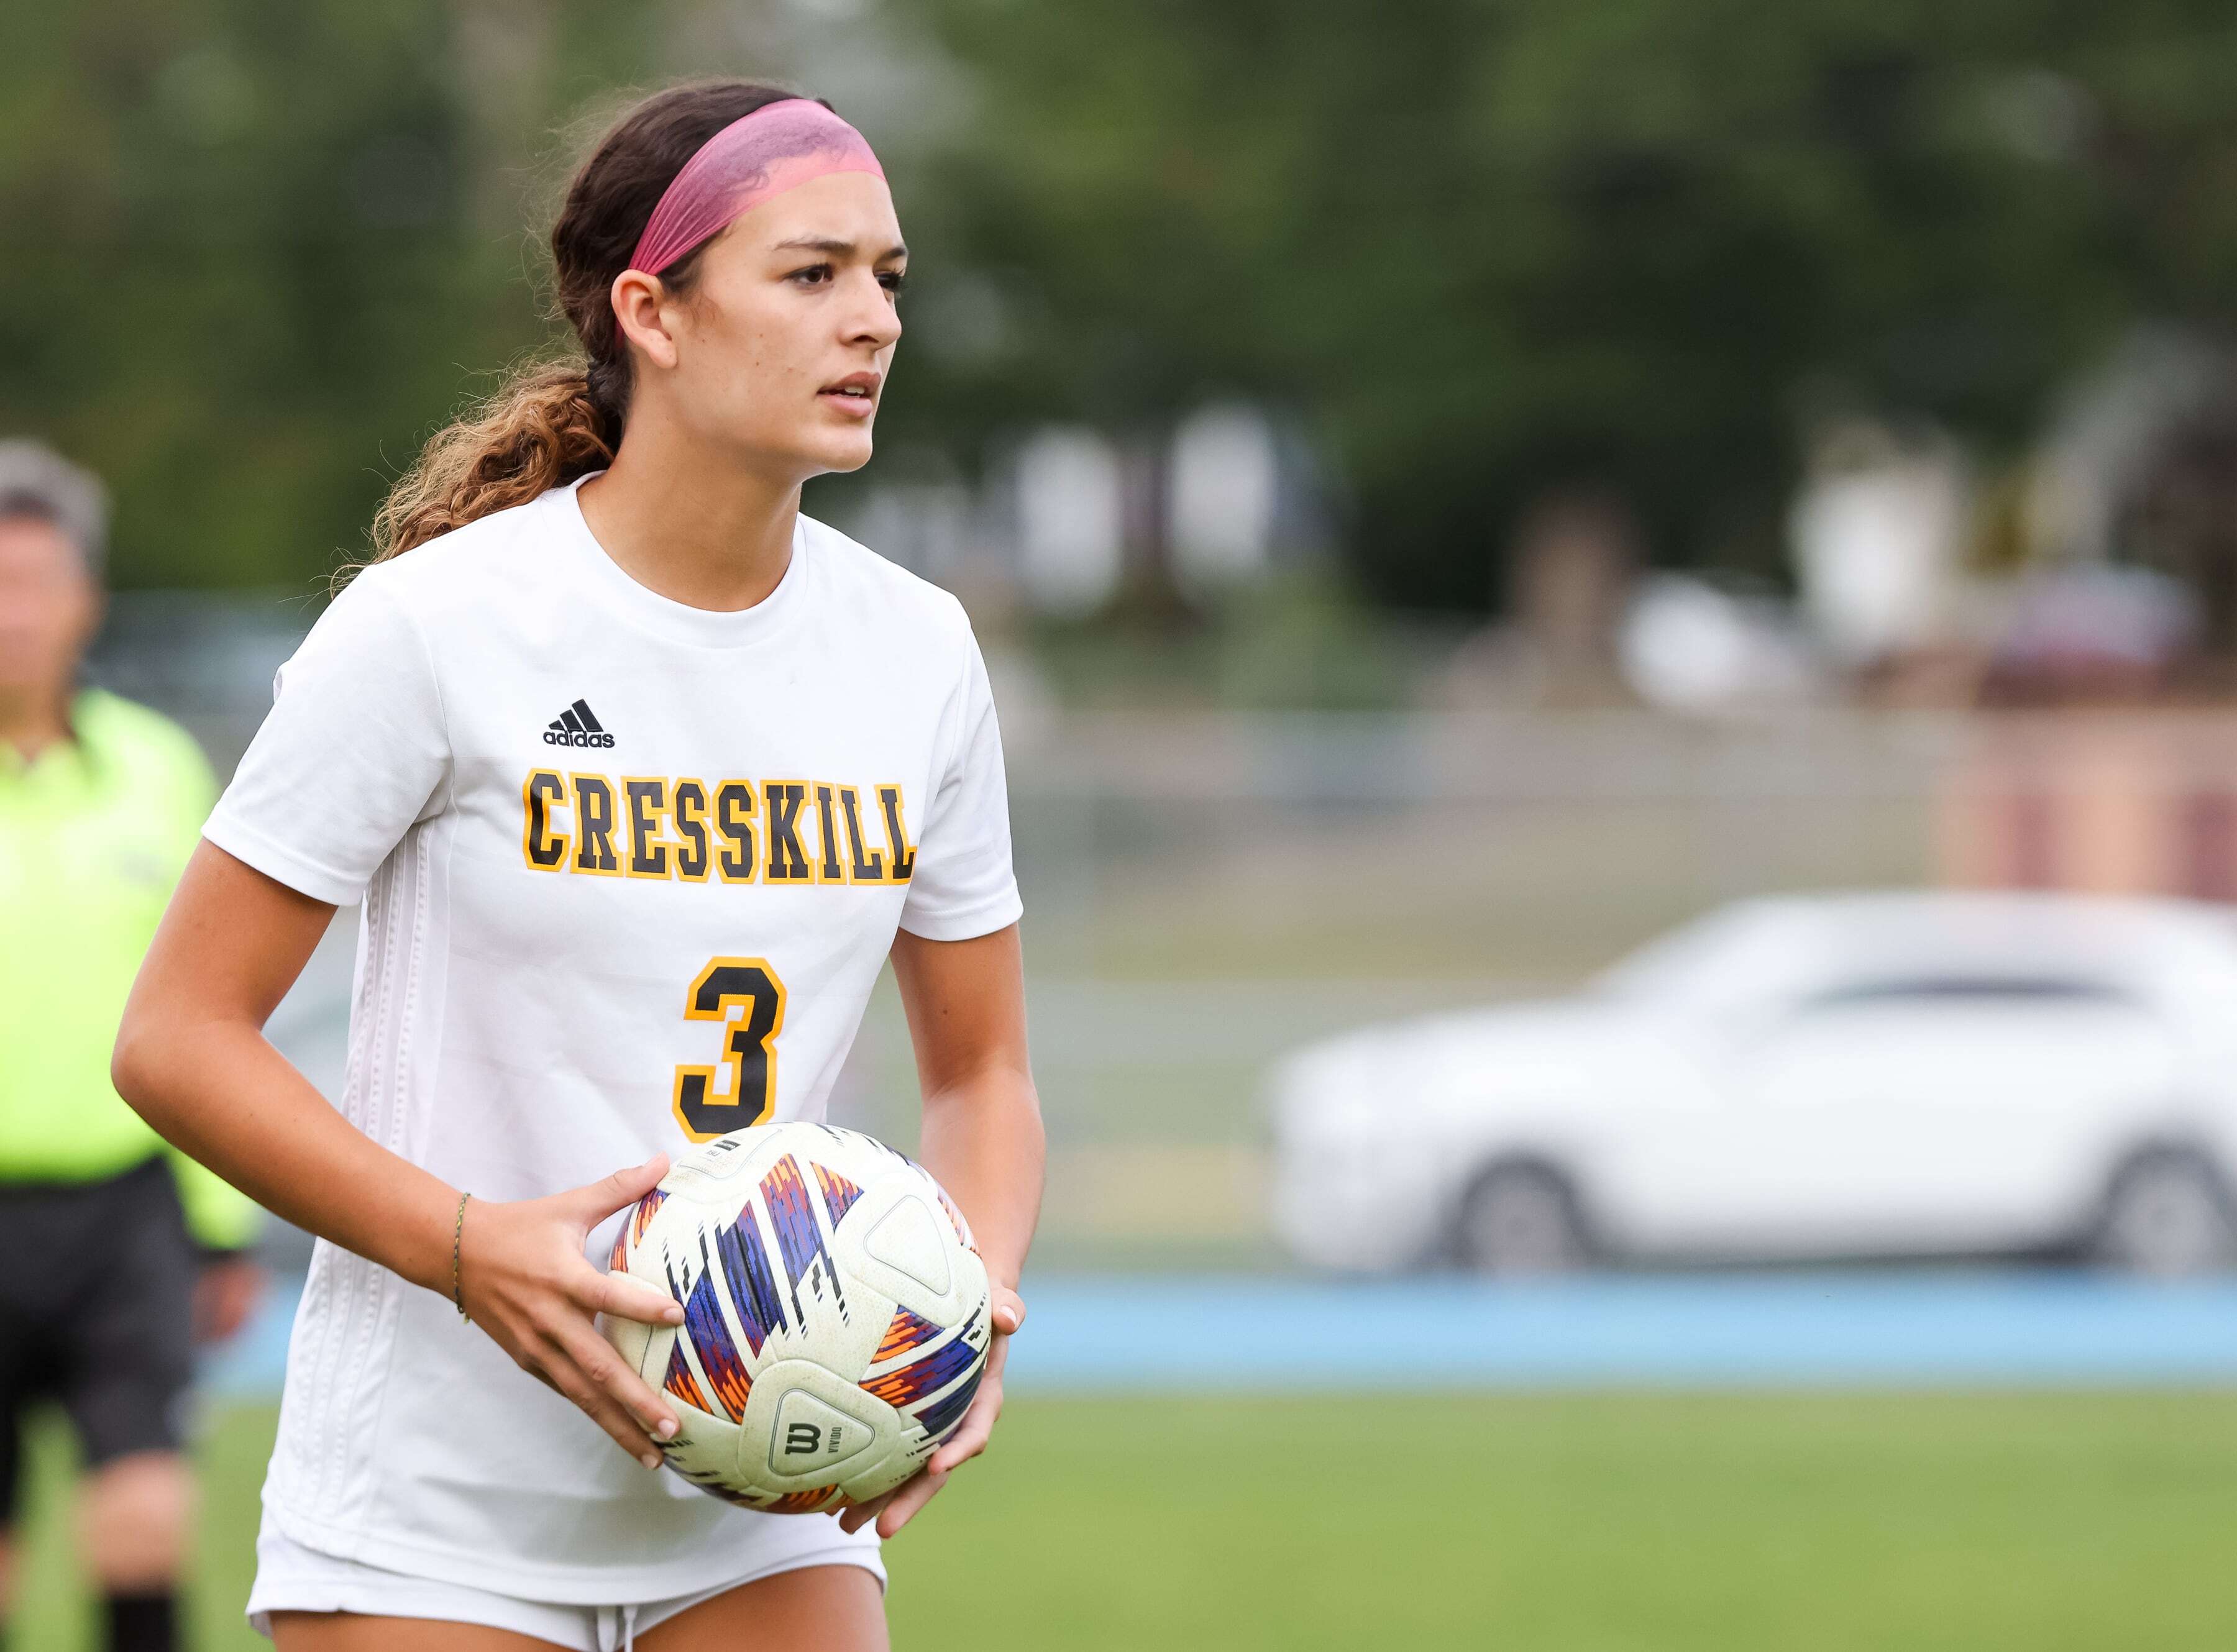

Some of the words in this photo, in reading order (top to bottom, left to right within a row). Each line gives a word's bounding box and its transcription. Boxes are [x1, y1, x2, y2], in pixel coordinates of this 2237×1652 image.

[543, 730, 615, 748] adidas
[523, 768, 917, 885] CRESSKILL
[672, 956, 788, 1144] 3
[828, 1426, 842, 1454] VIVIDO
